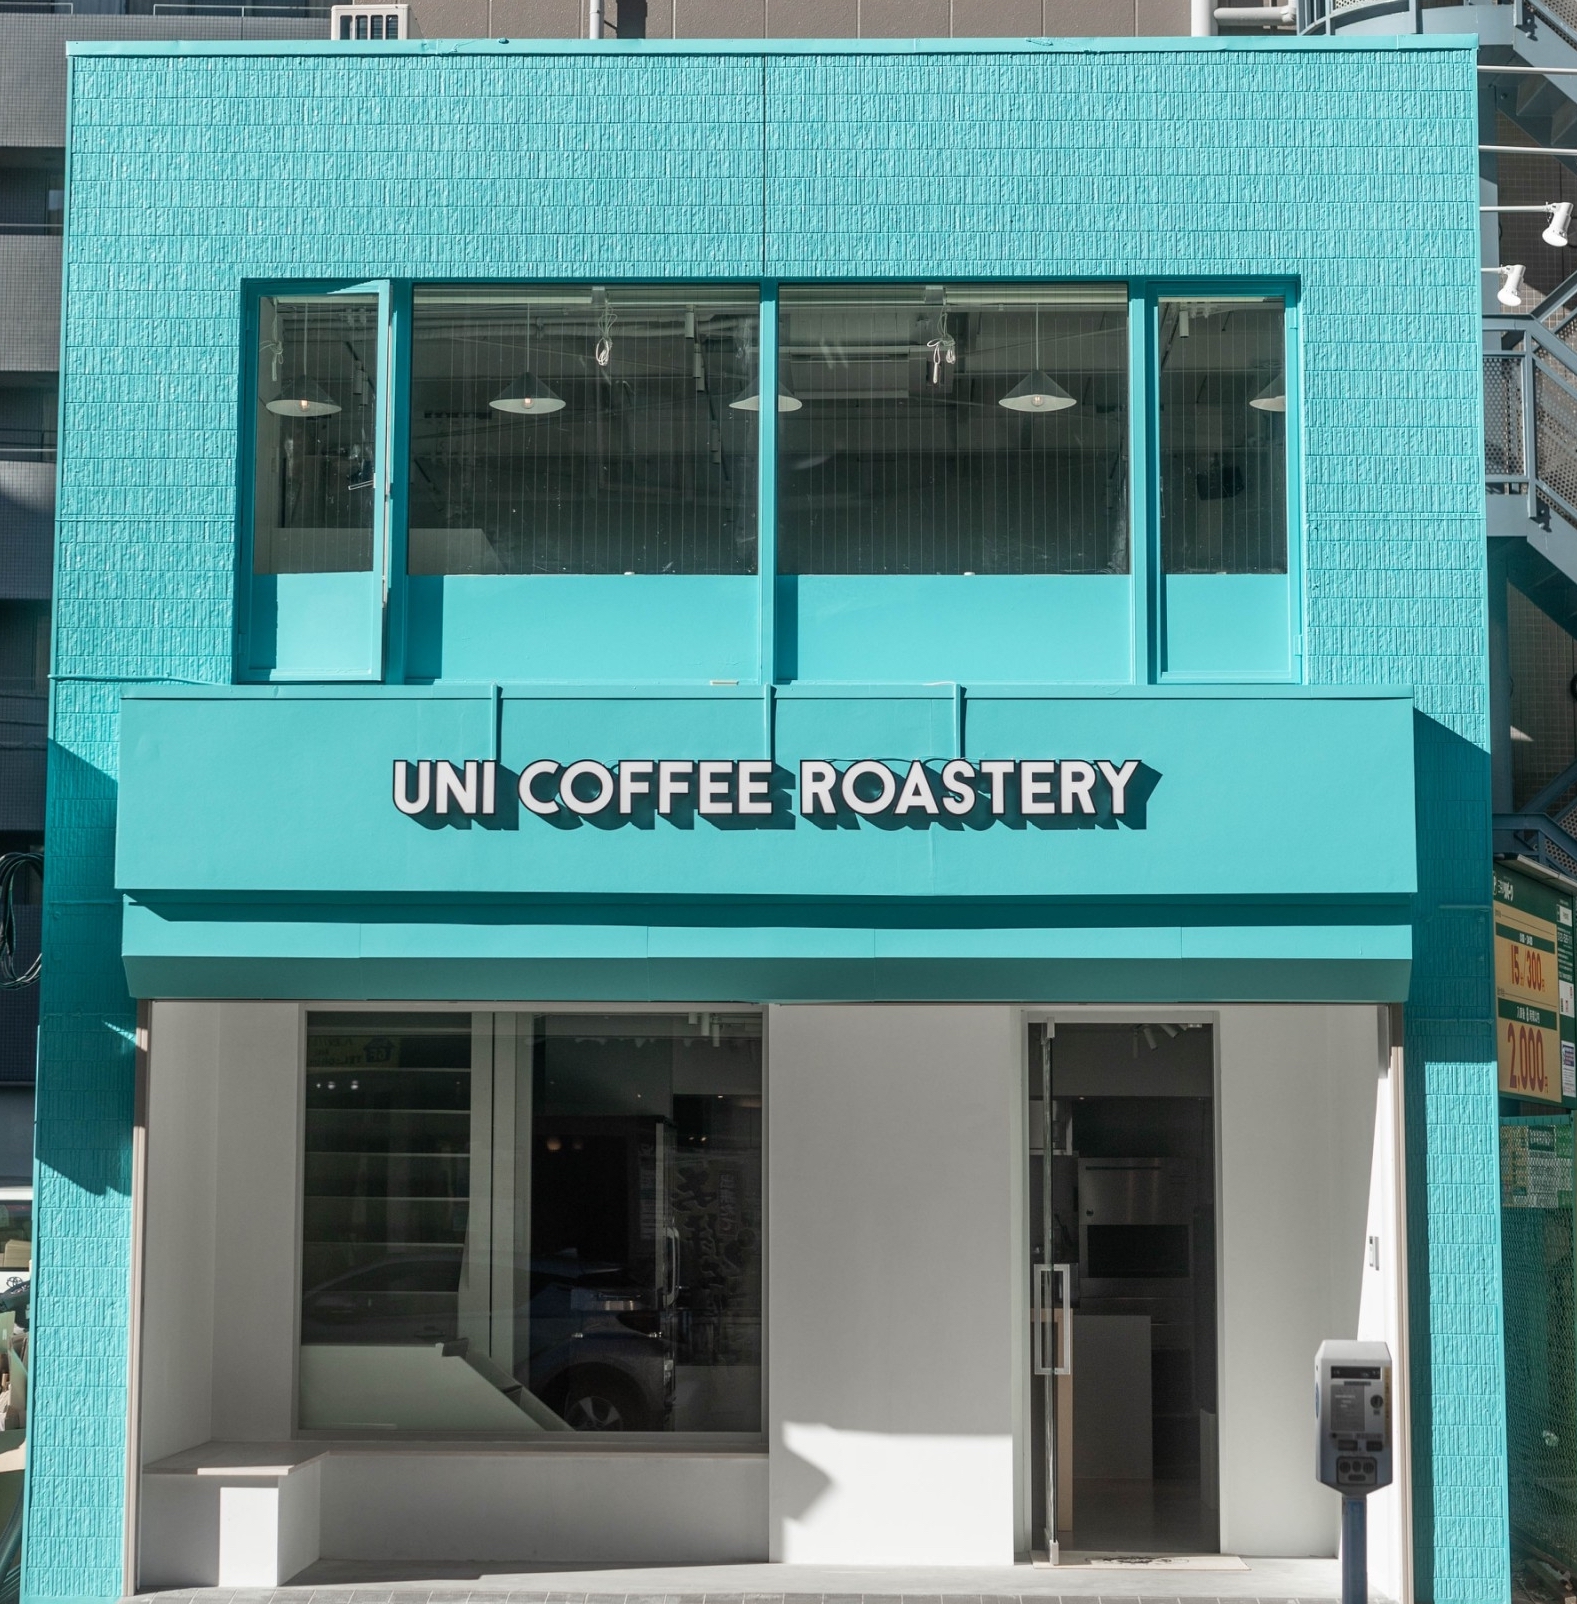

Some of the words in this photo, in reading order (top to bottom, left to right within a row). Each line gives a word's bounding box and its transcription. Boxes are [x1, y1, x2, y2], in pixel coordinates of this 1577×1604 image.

[393, 760, 496, 815] UNI
[517, 759, 774, 815] COFFEE
[800, 759, 1142, 815] ROASTERY
